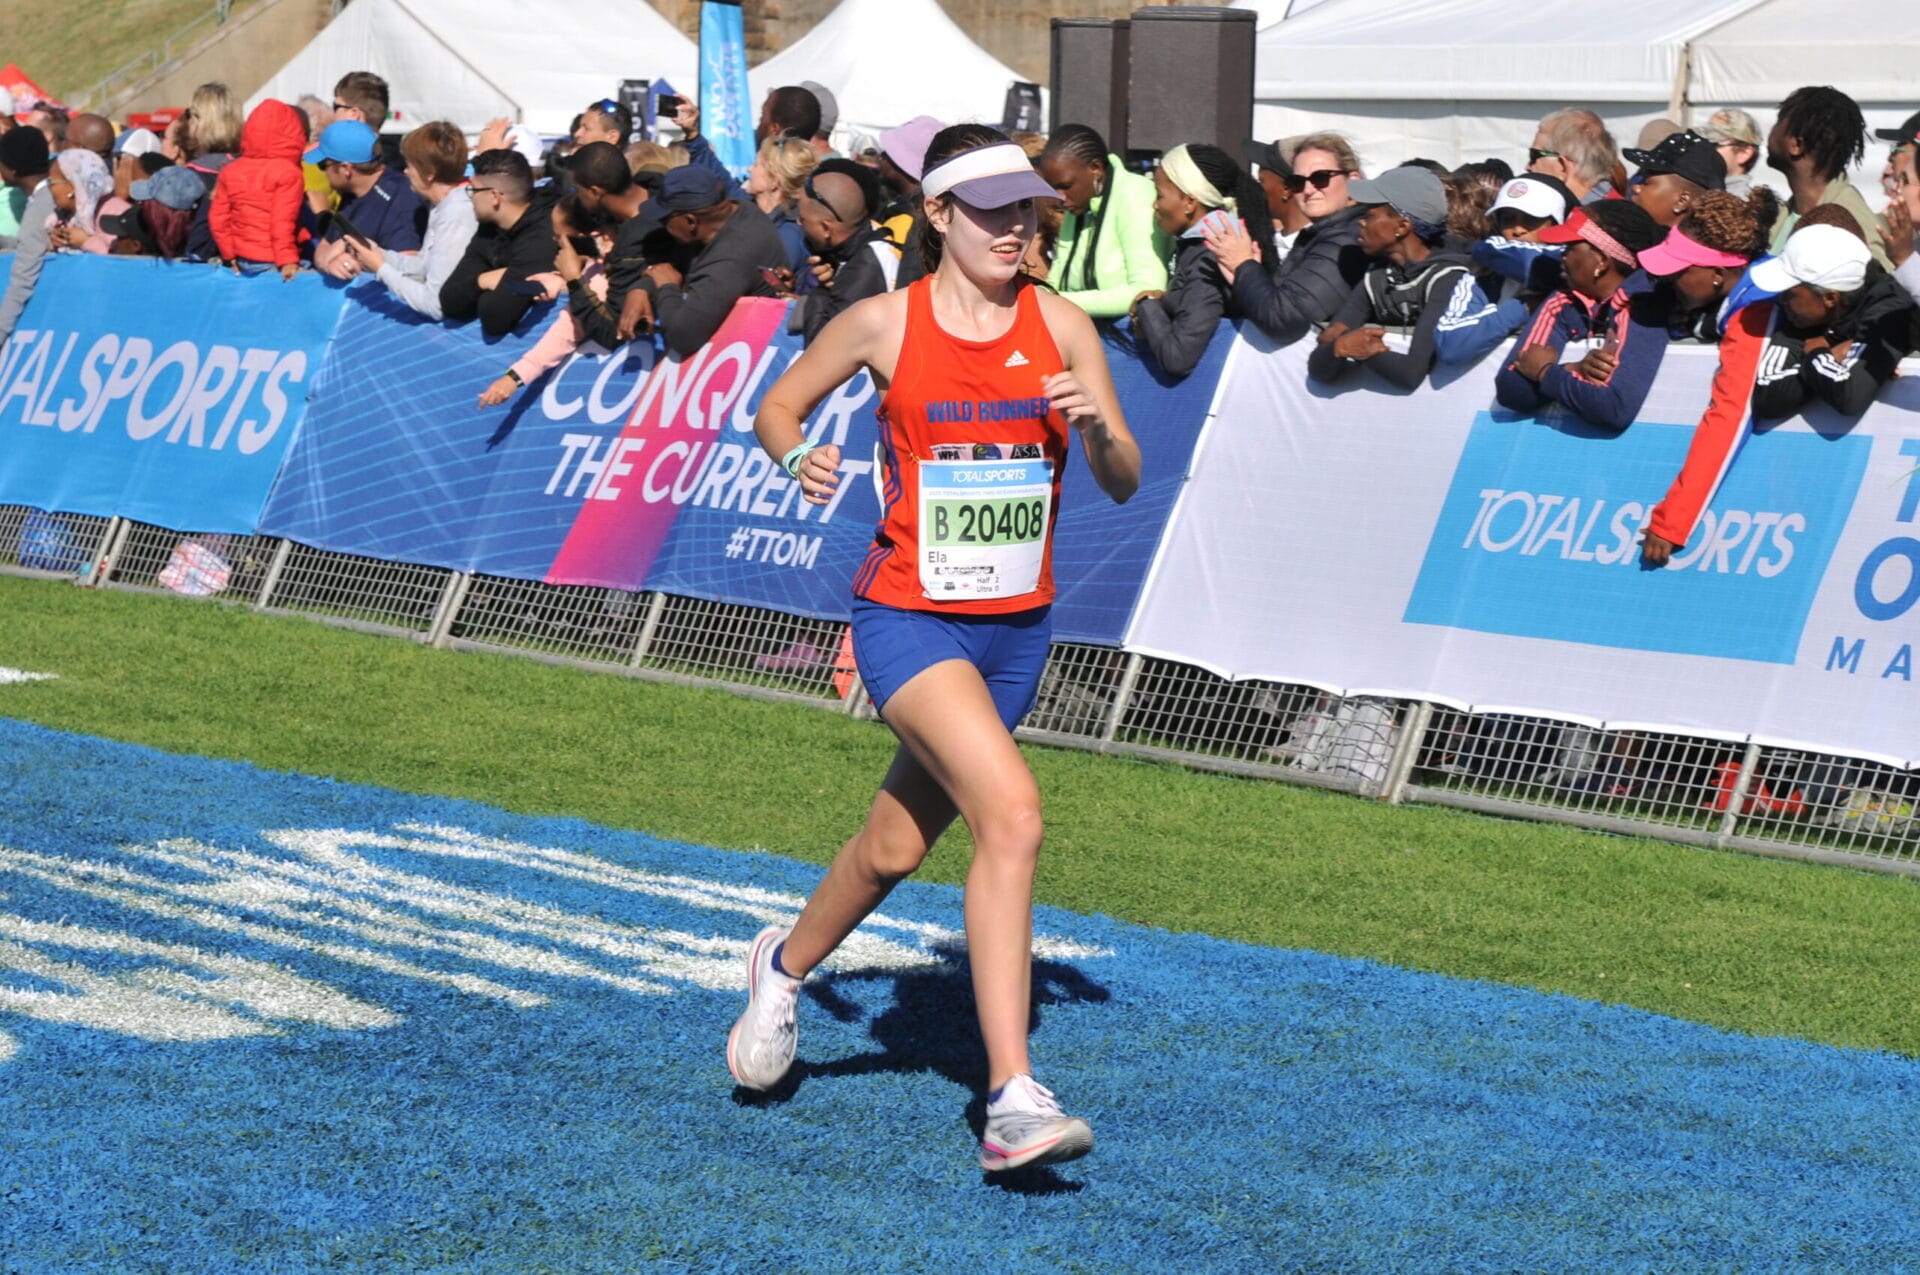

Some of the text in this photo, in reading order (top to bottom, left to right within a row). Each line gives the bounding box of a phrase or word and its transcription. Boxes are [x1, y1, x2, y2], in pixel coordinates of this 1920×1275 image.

[0, 330, 308, 455] TALSPORTS
[541, 340, 877, 446] CONQUR
[926, 401, 974, 423] WILD
[544, 433, 647, 501] THE
[1014, 446, 1040, 458] ASA
[952, 468, 1027, 483] TOTALSPORTS
[934, 501, 1043, 542] B 20408
[725, 526, 823, 570] #TTOM
[928, 551, 947, 563] Ela
